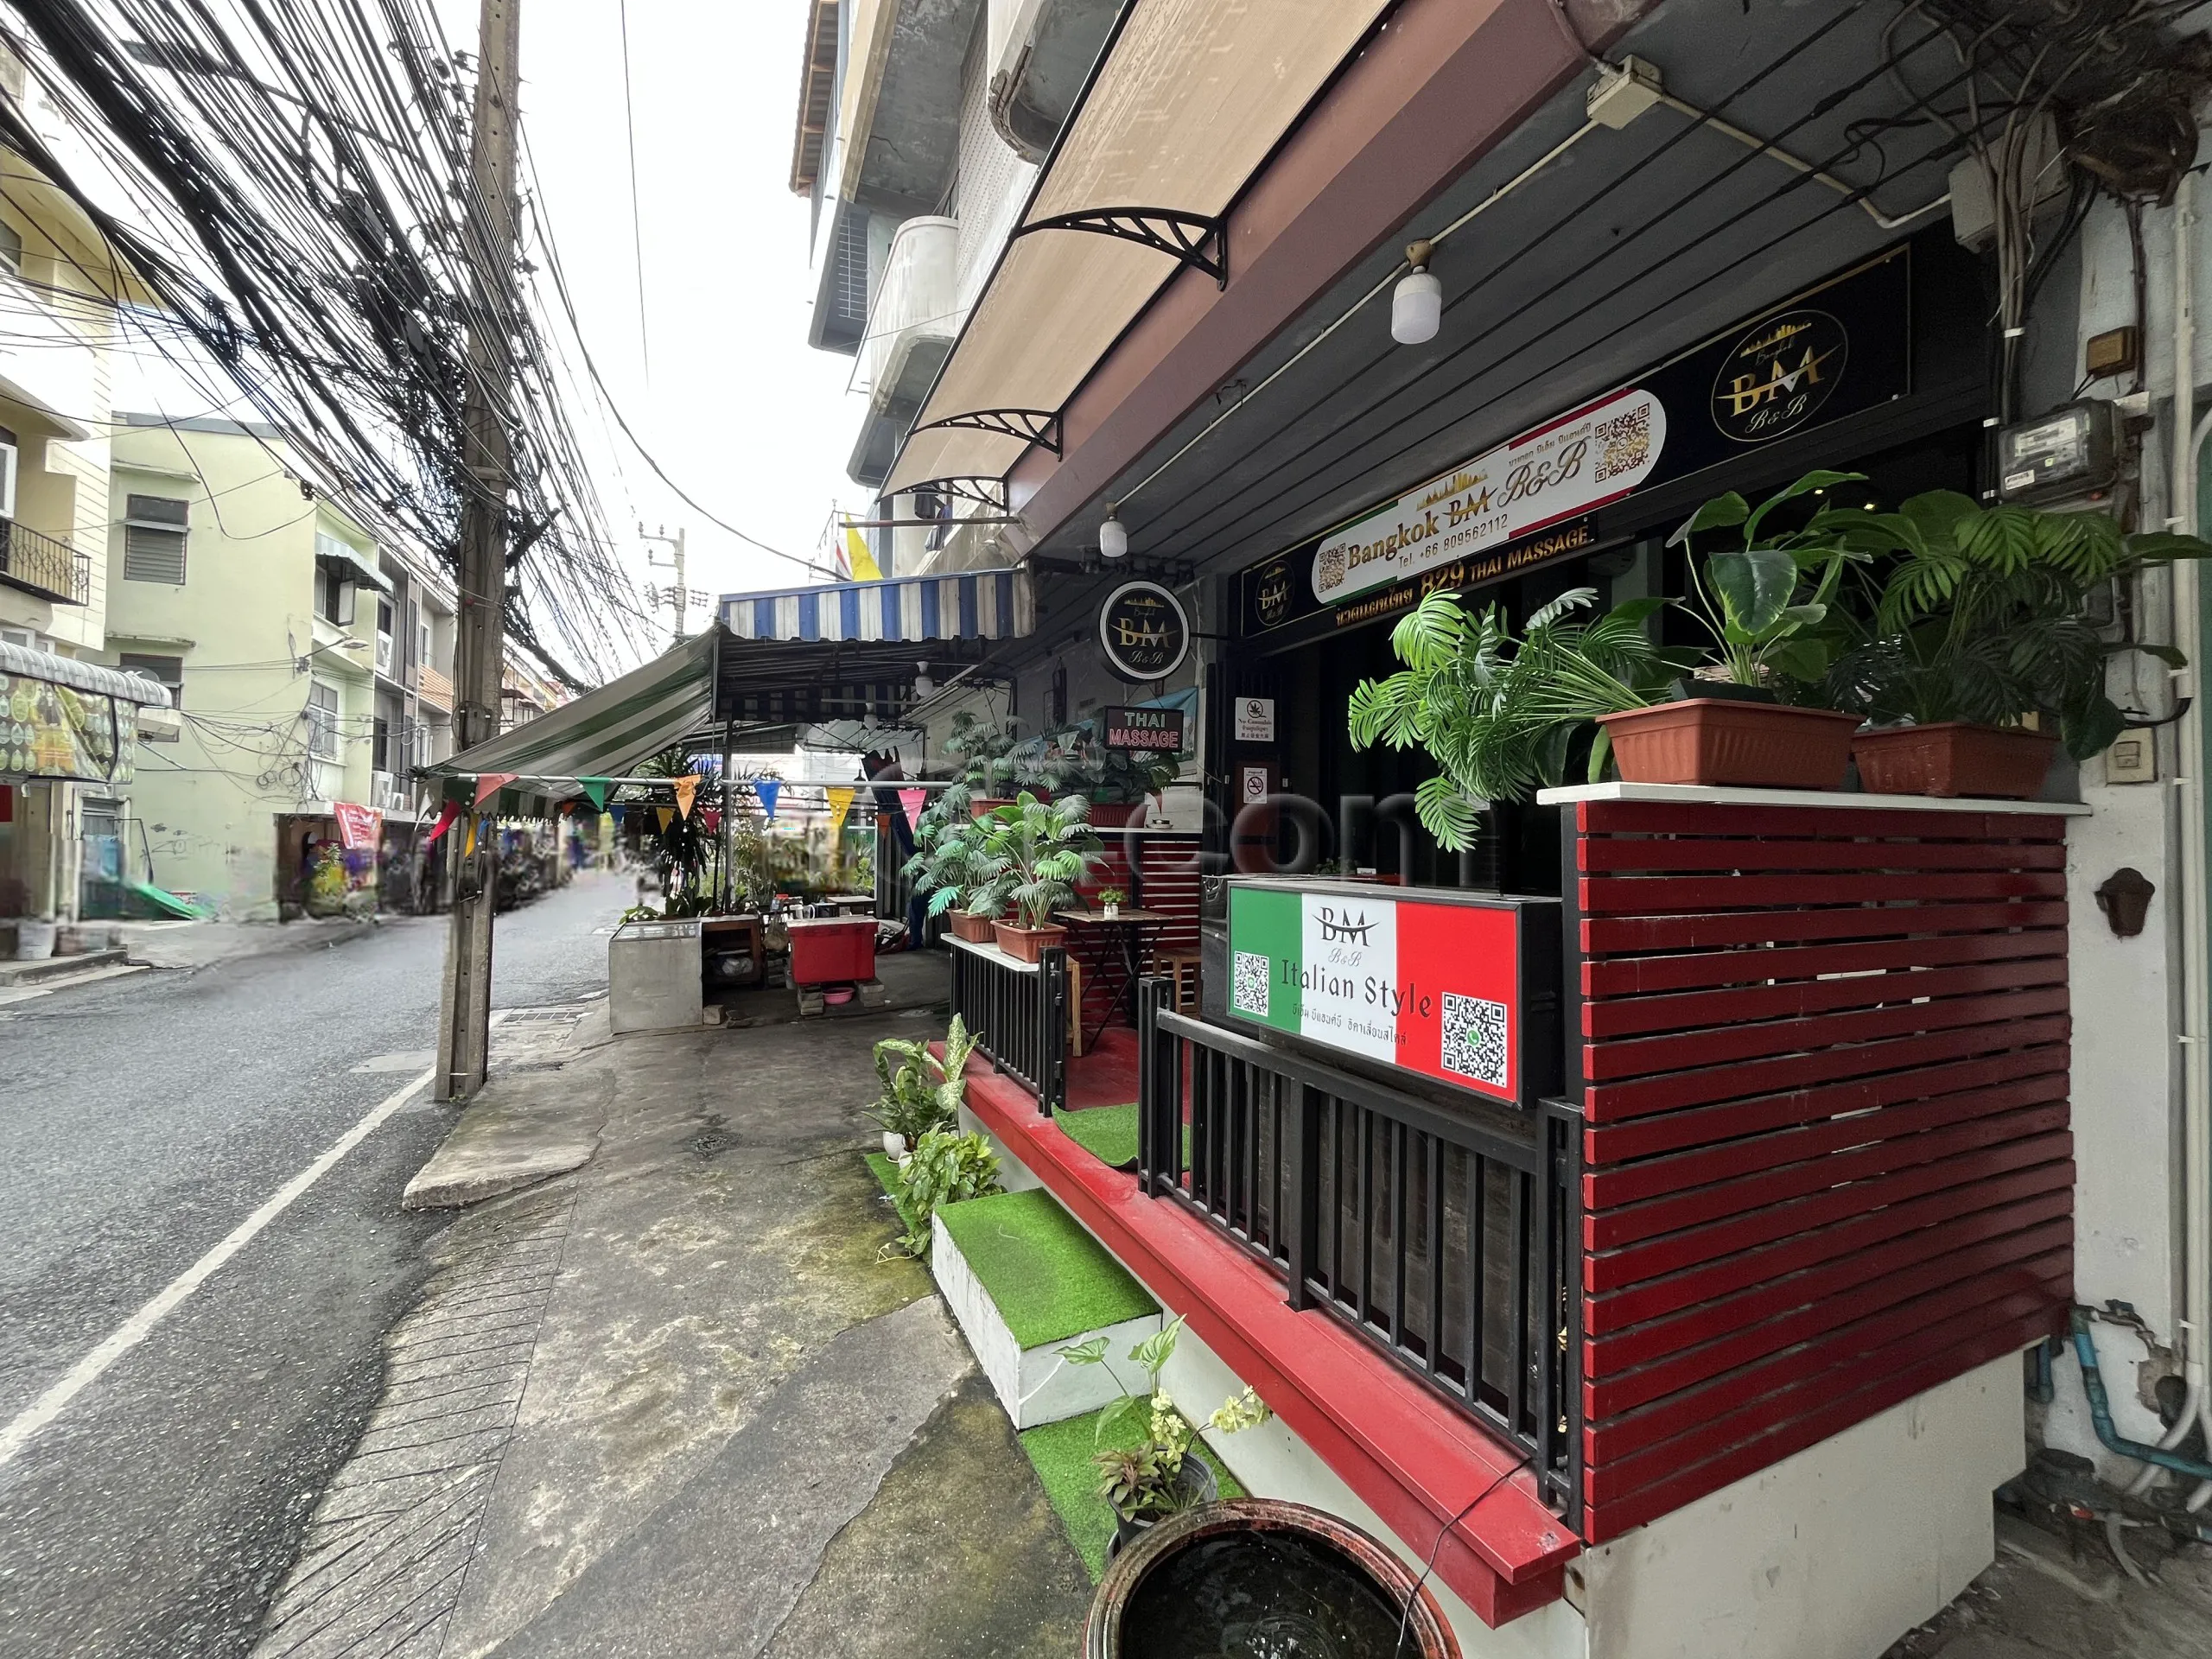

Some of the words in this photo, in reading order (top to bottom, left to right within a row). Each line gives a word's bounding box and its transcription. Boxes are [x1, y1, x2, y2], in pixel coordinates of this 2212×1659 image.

[1347, 511, 1440, 570] Bangkok
[1497, 435, 1592, 507] B&B
[1420, 543, 1439, 558] +66
[1443, 514, 1508, 551] 809562112
[1421, 562, 1465, 597] 829
[1469, 556, 1502, 582] THAI
[1506, 524, 1589, 570] MASSAGE
[1109, 728, 1179, 748] MASSAGE
[1124, 711, 1166, 728] THAI
[1281, 959, 1354, 999] Italian
[1364, 976, 1432, 1018] Style
